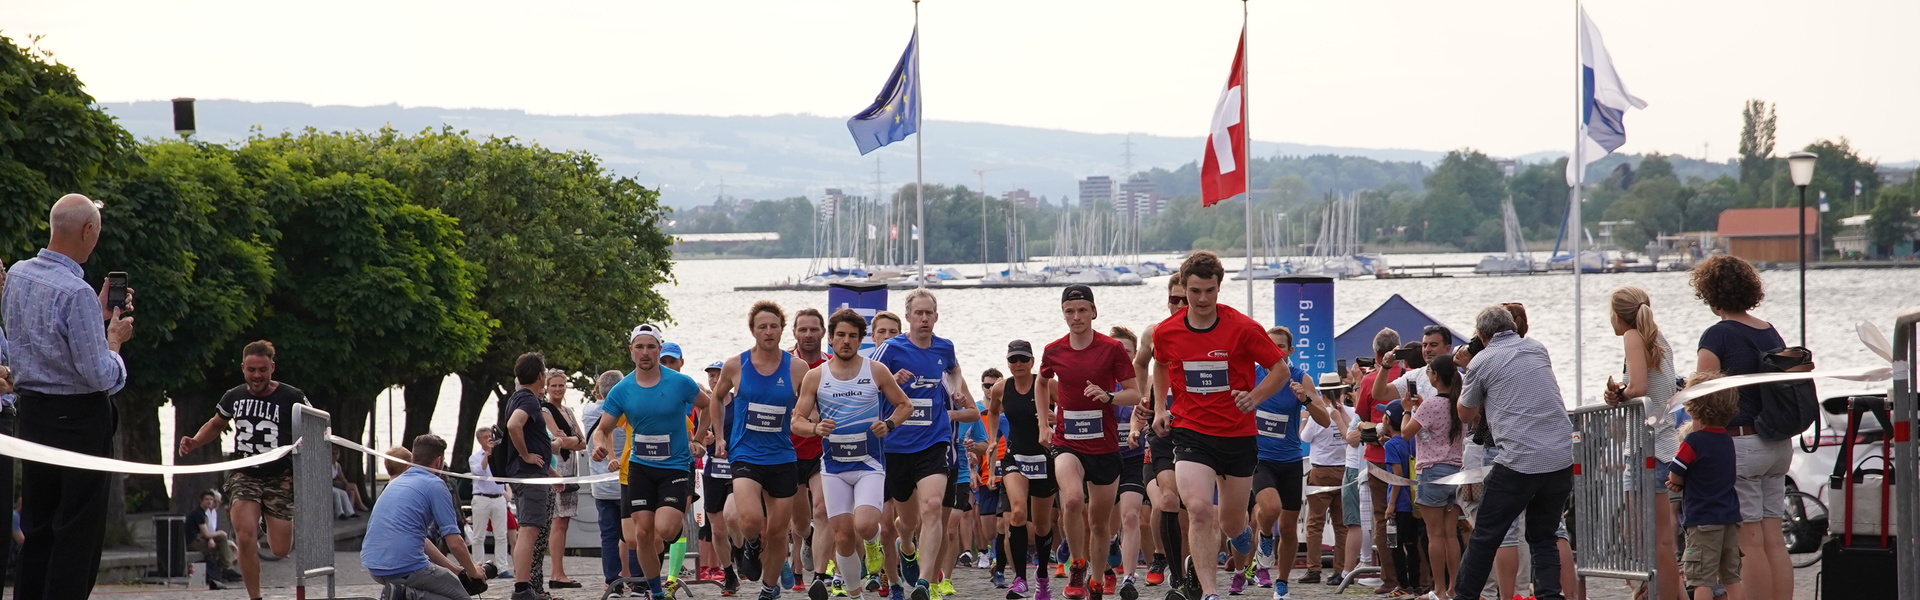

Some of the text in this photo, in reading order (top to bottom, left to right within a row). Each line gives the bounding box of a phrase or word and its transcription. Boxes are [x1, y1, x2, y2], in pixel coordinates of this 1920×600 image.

[832, 390, 862, 398] medica
[232, 399, 279, 423] SEVILLA
[756, 413, 776, 421] Dominic
[236, 419, 279, 454] 23
[1021, 464, 1039, 472] 2014
